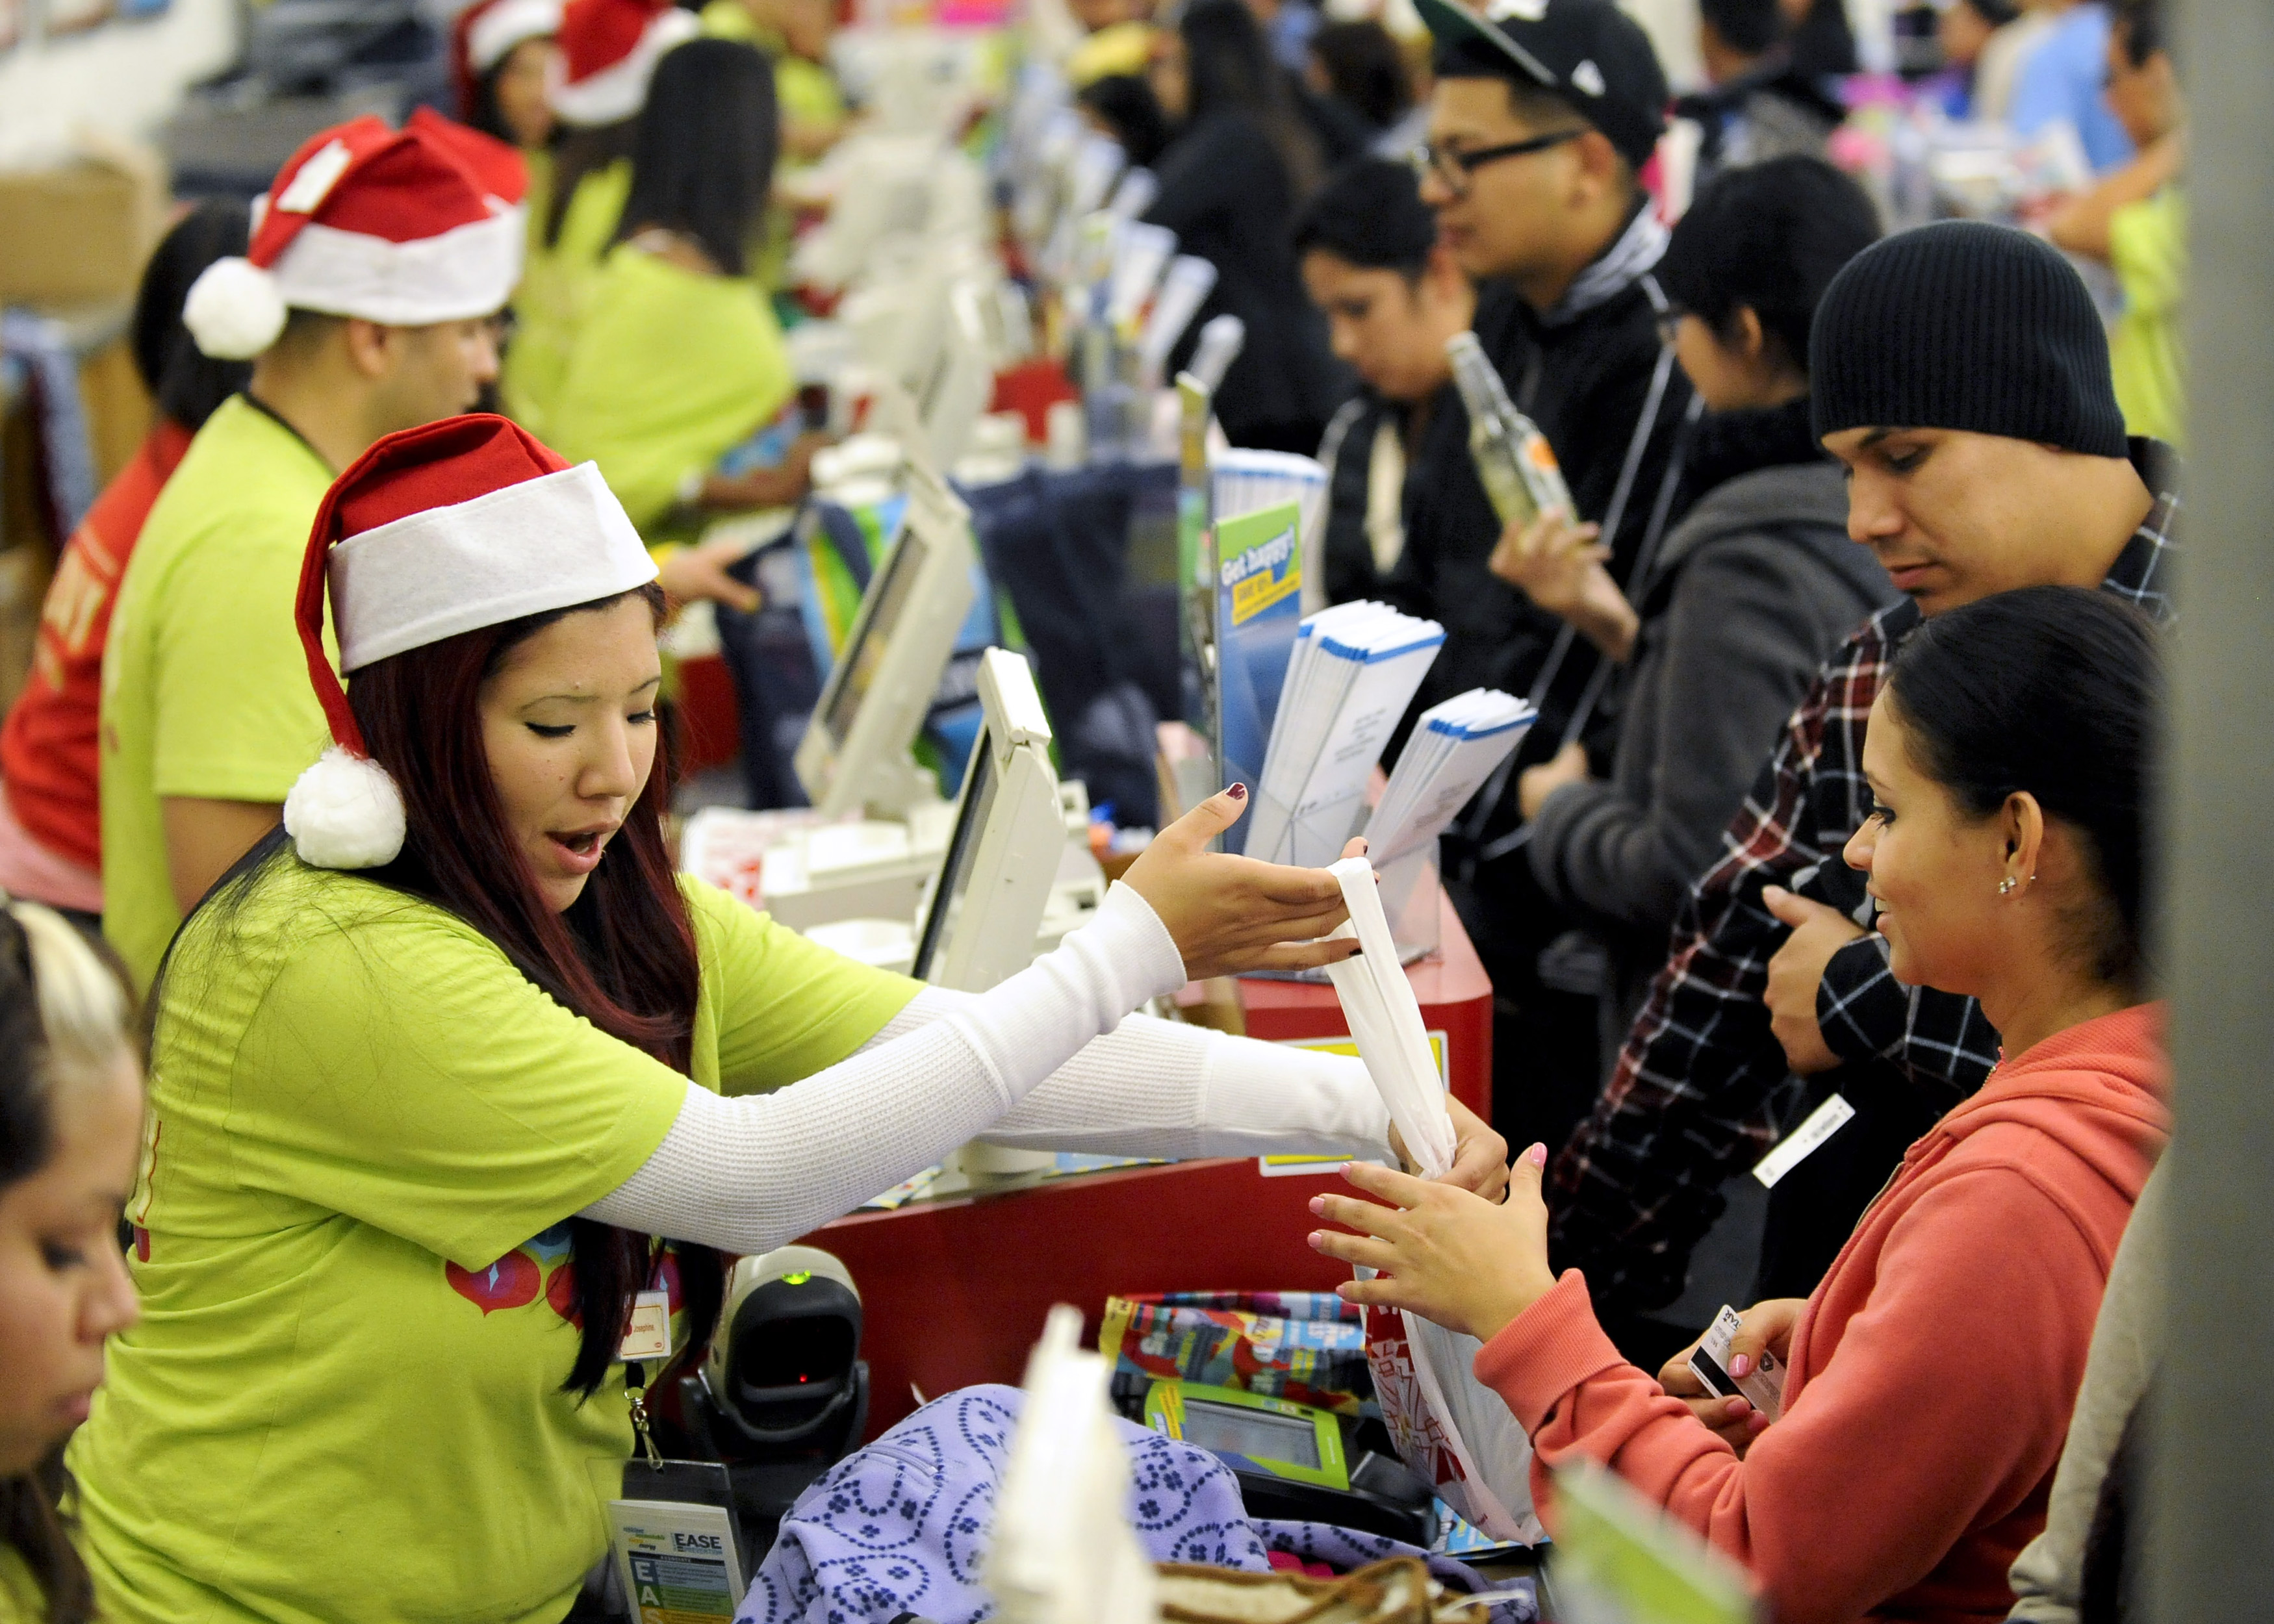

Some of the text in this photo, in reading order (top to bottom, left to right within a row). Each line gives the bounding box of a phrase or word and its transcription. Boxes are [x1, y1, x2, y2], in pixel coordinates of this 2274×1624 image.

[1724, 1309, 1742, 1330] TAR
[674, 1533, 722, 1549] EASE
[635, 1560, 654, 1582] E
[641, 1586, 660, 1606] A
